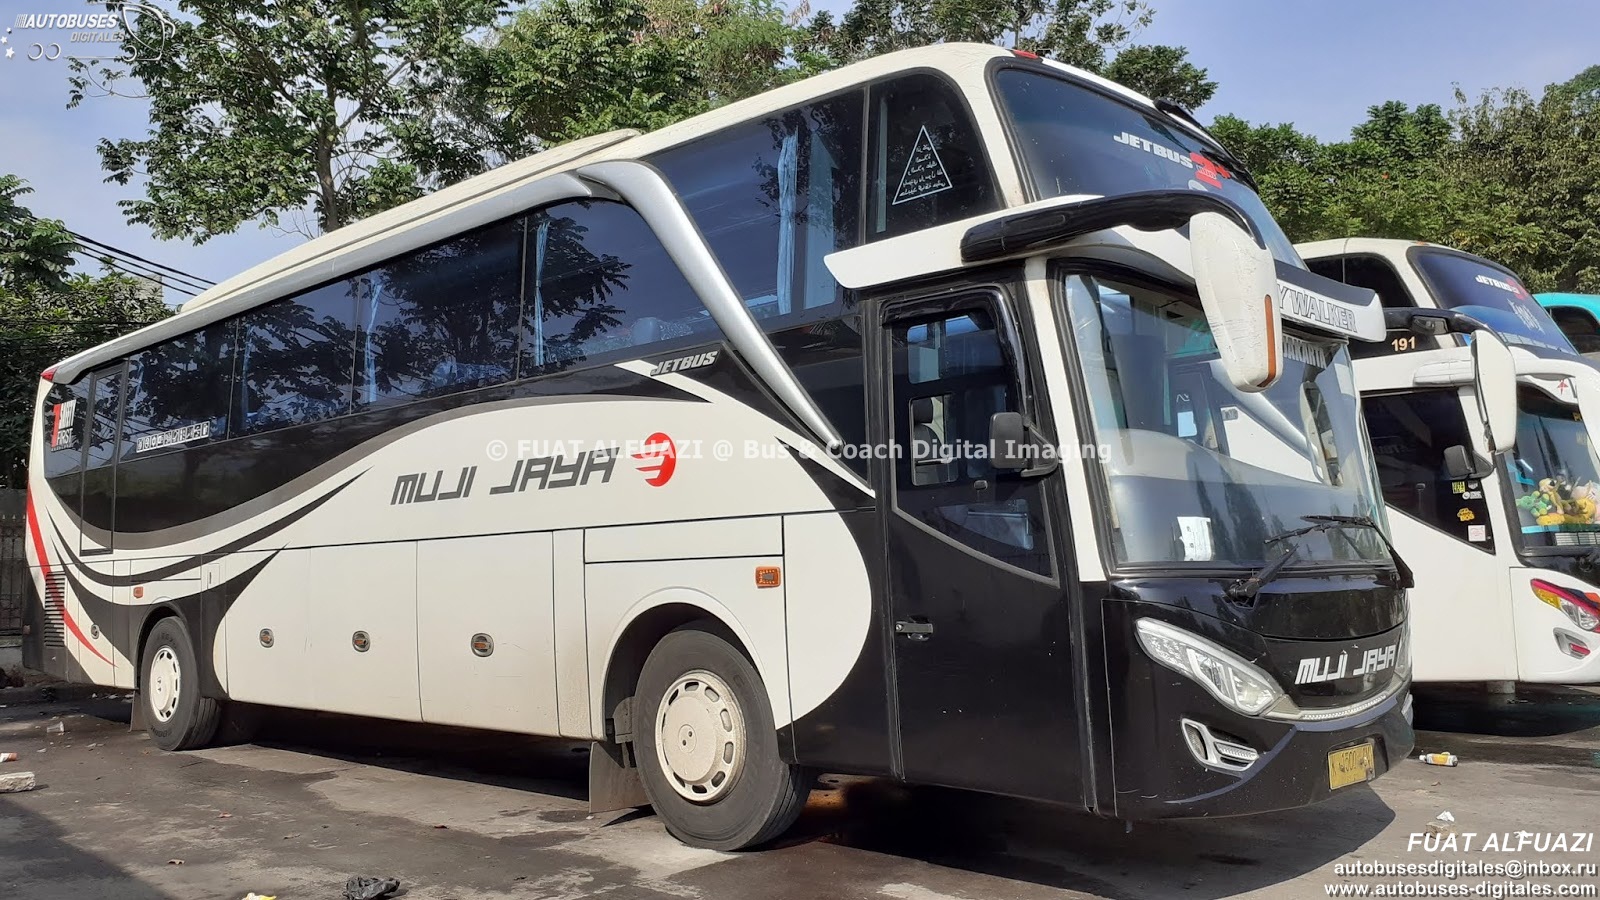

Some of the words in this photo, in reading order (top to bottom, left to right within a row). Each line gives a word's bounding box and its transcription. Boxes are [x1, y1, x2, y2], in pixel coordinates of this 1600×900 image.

[1391, 336, 1416, 351] 191
[650, 350, 718, 376] JETBUS
[390, 465, 478, 505] MUJI
[489, 446, 620, 495] JAYA
[1294, 653, 1349, 685] MUJI
[1352, 644, 1397, 676] JAYA
